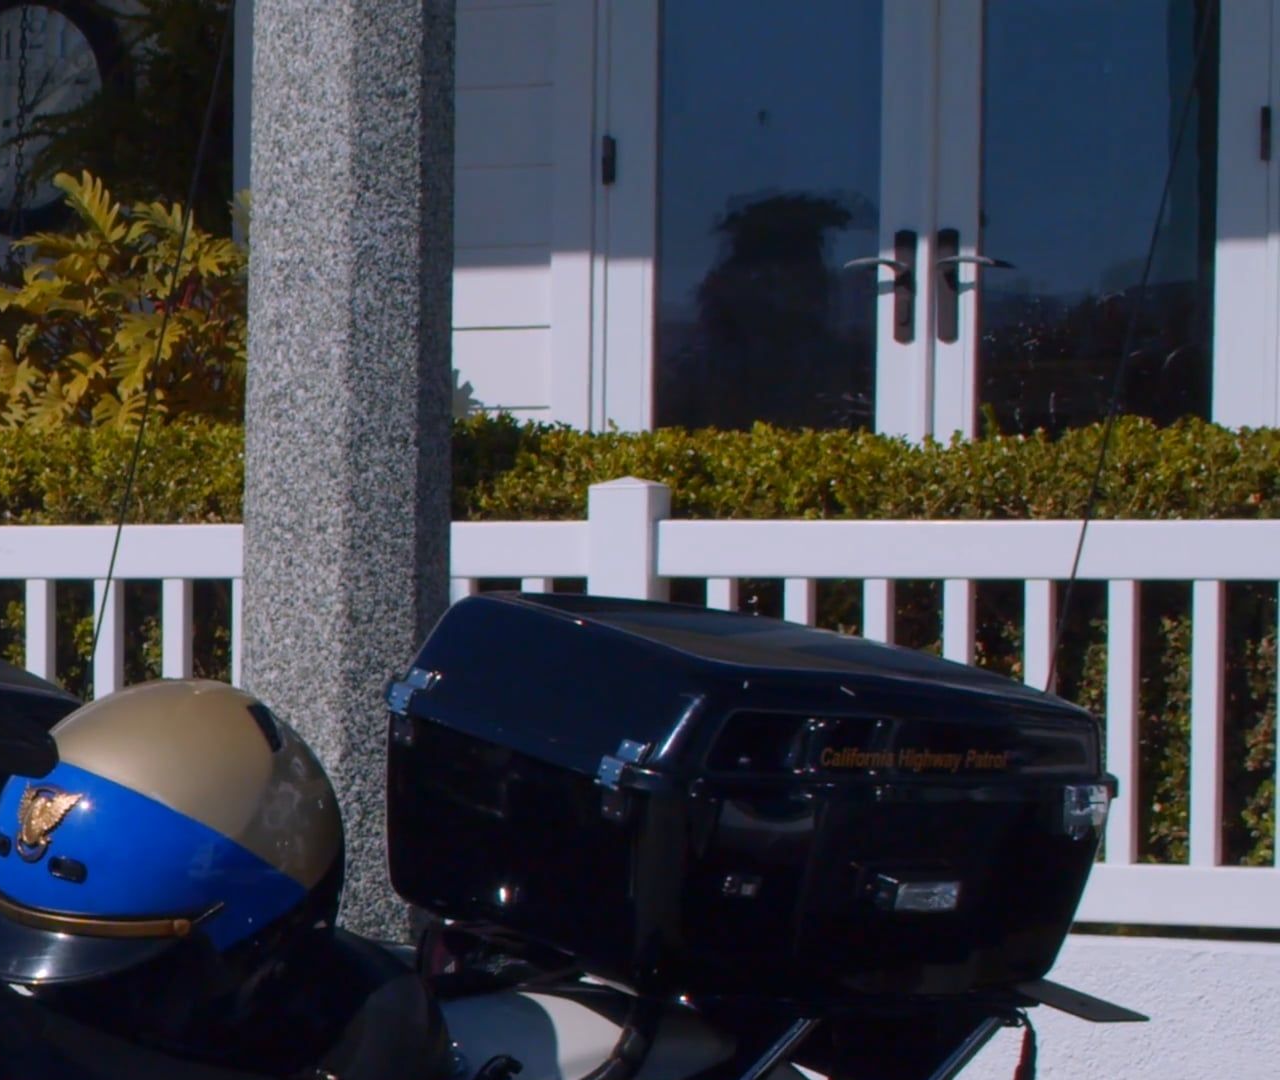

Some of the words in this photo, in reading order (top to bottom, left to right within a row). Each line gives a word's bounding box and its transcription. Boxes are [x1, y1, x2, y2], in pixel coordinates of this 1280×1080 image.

[820, 747, 896, 769] California
[897, 747, 963, 774] Highway
[964, 748, 1008, 769] Patrol
